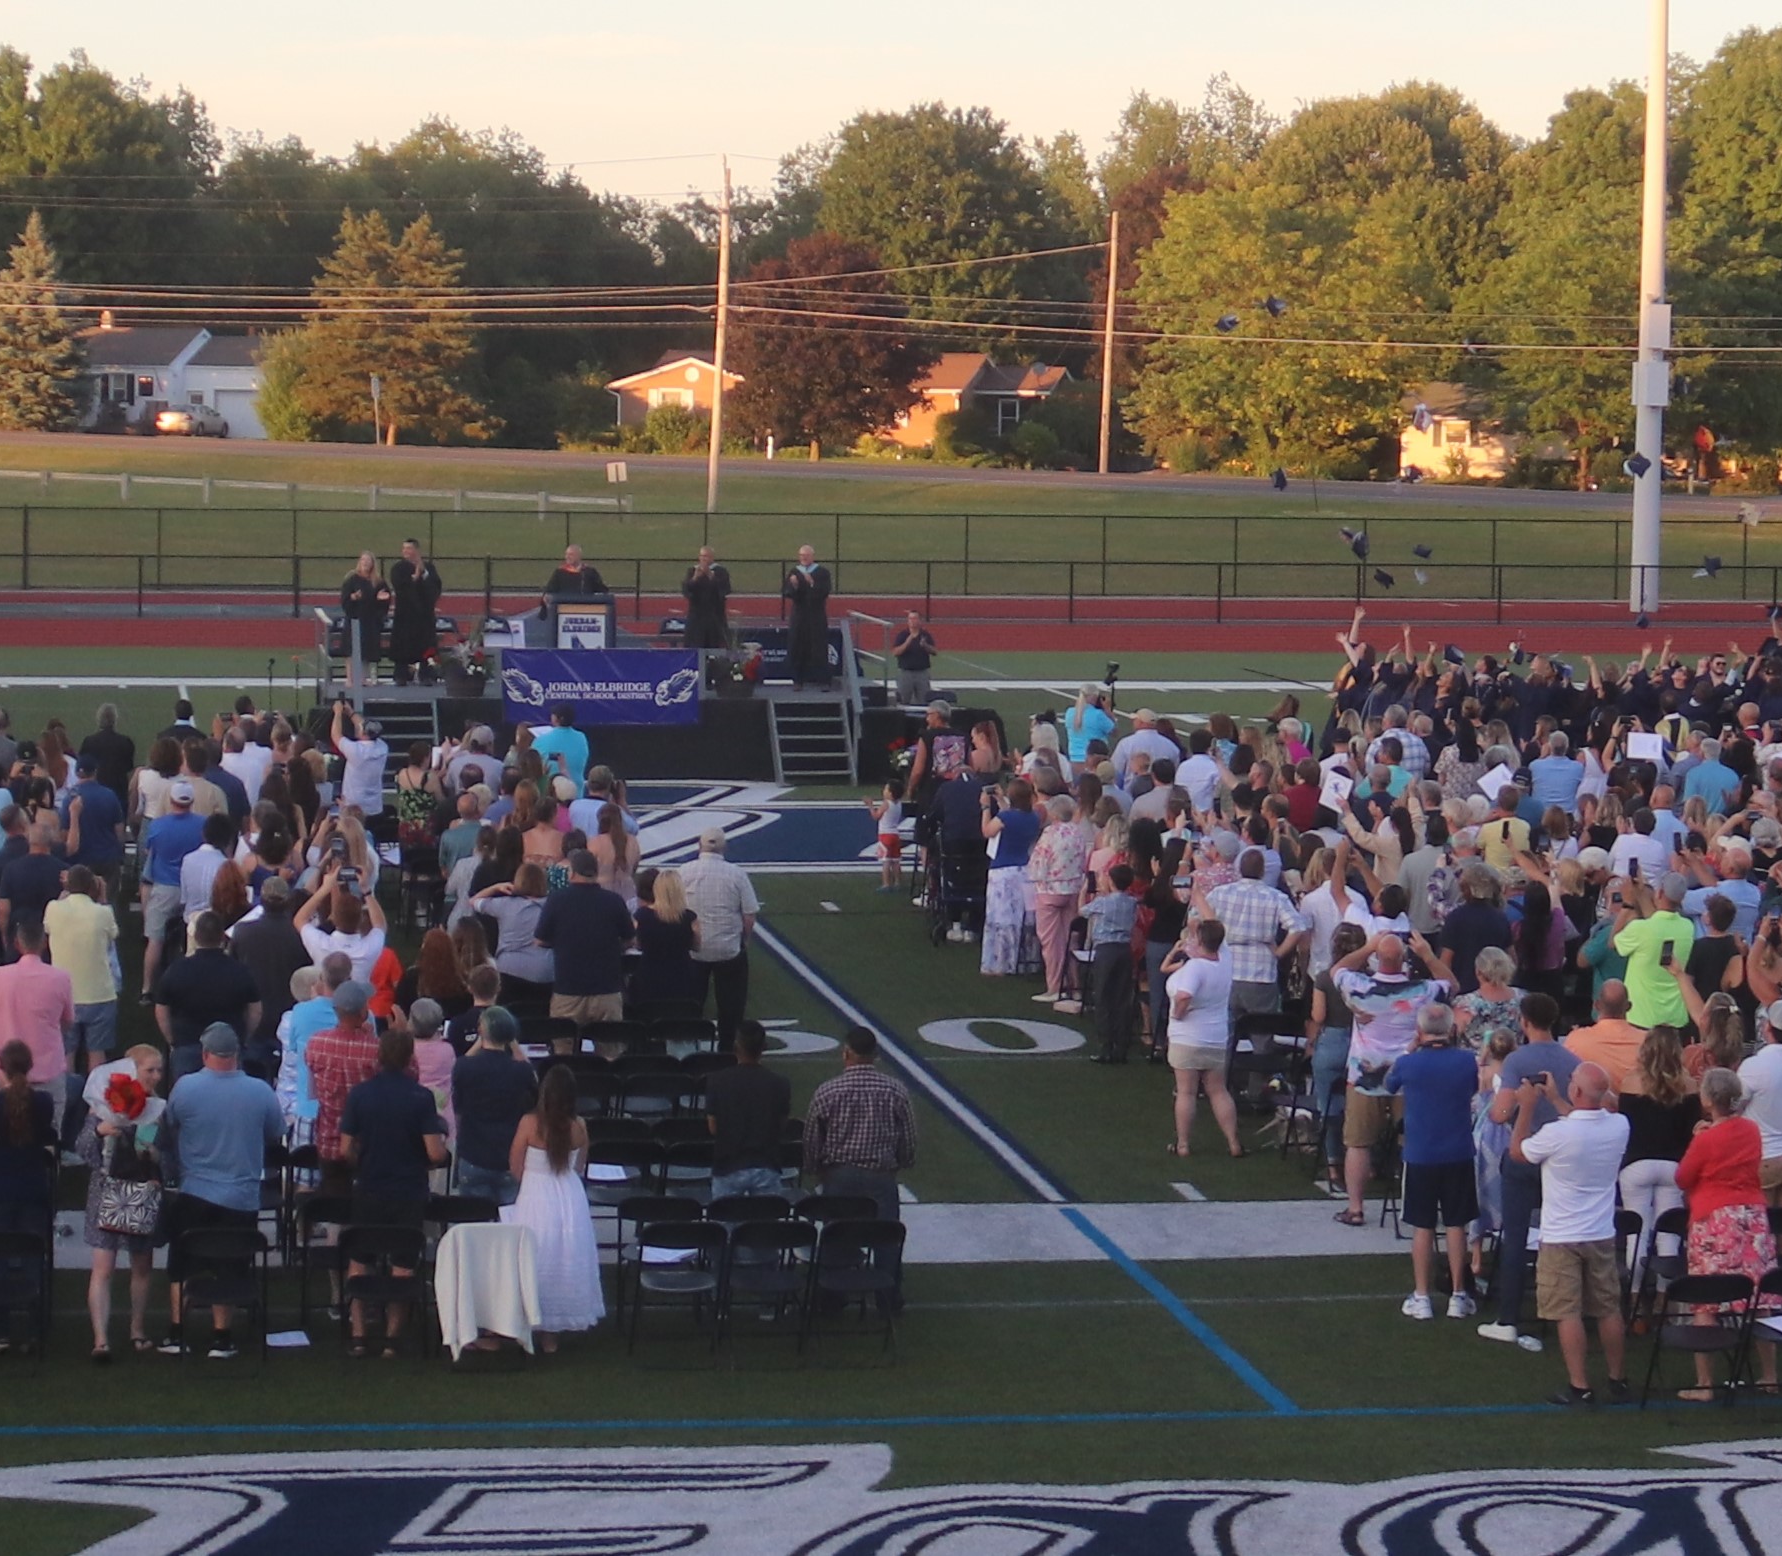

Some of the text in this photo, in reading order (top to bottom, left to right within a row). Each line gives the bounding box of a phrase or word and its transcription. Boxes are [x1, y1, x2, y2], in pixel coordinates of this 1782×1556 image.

[545, 682, 651, 692] JORDAN-ELBRIDGE
[545, 692, 654, 700] CENTRAL SCHOOL DISTRICT
